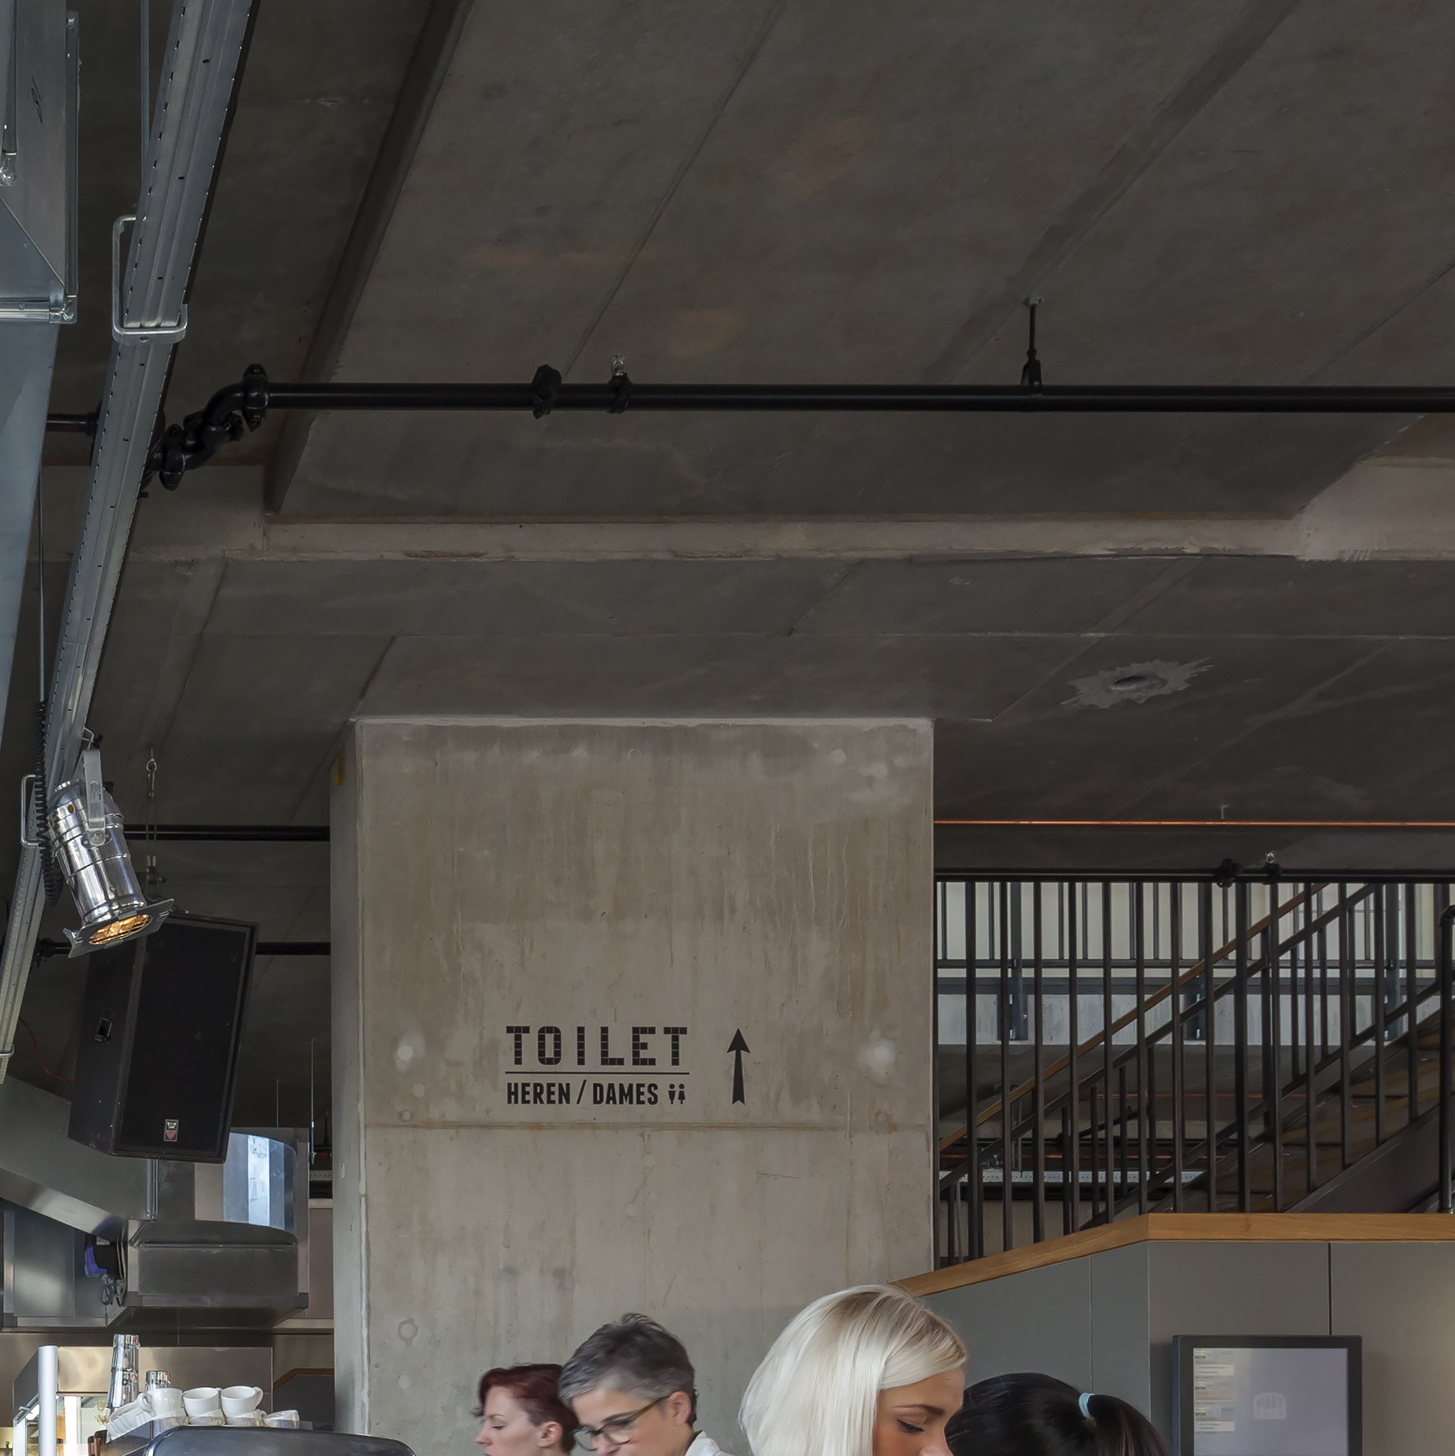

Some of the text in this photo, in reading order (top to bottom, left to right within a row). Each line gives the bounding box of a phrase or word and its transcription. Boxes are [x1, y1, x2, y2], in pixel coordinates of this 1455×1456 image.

[506, 1026, 688, 1066] TOILET
[506, 1082, 570, 1105] HEREN
[592, 1082, 659, 1105] DAMES
